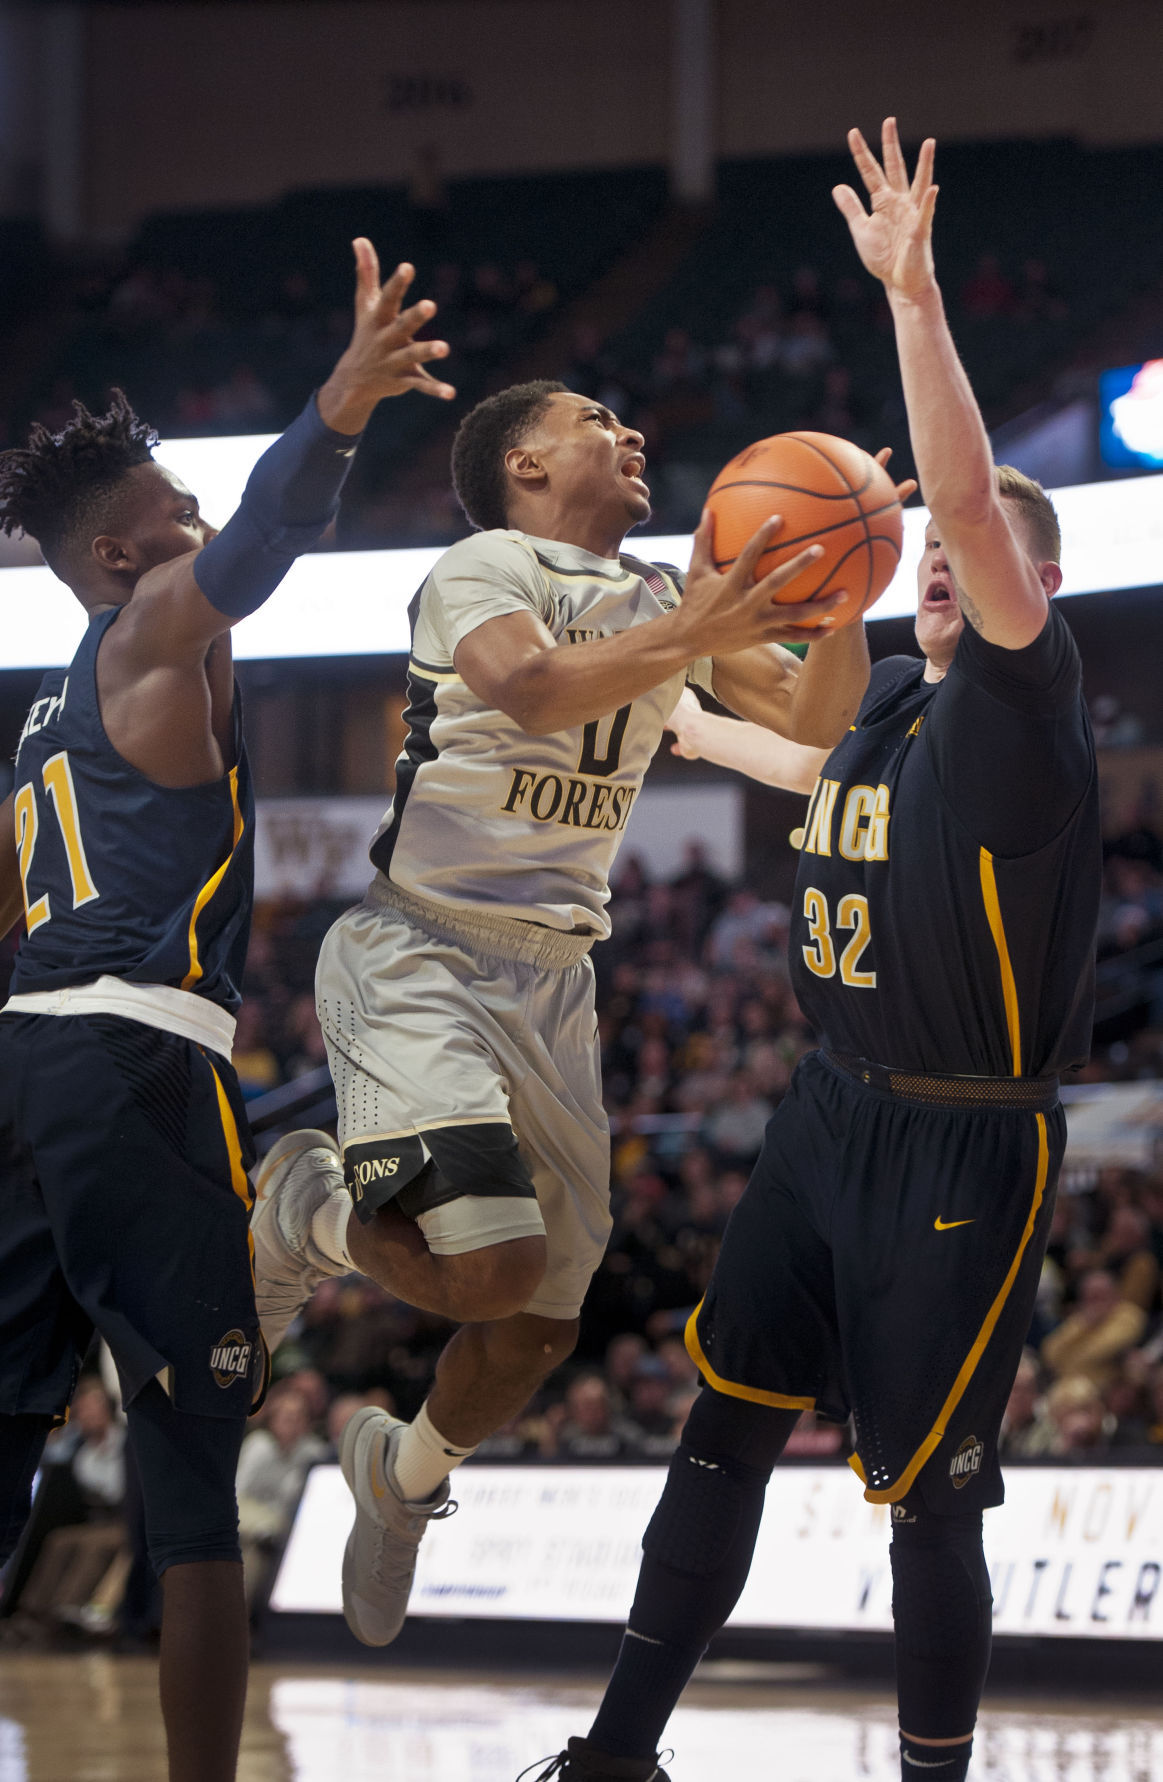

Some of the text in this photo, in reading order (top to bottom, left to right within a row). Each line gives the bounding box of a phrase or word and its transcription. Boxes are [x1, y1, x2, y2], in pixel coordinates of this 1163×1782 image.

[14, 750, 100, 941] 21
[802, 886, 877, 989] 32
[210, 1345, 251, 1373] UNCG
[949, 1444, 981, 1476] UNCG
[991, 1558, 1163, 1624] UTLER
